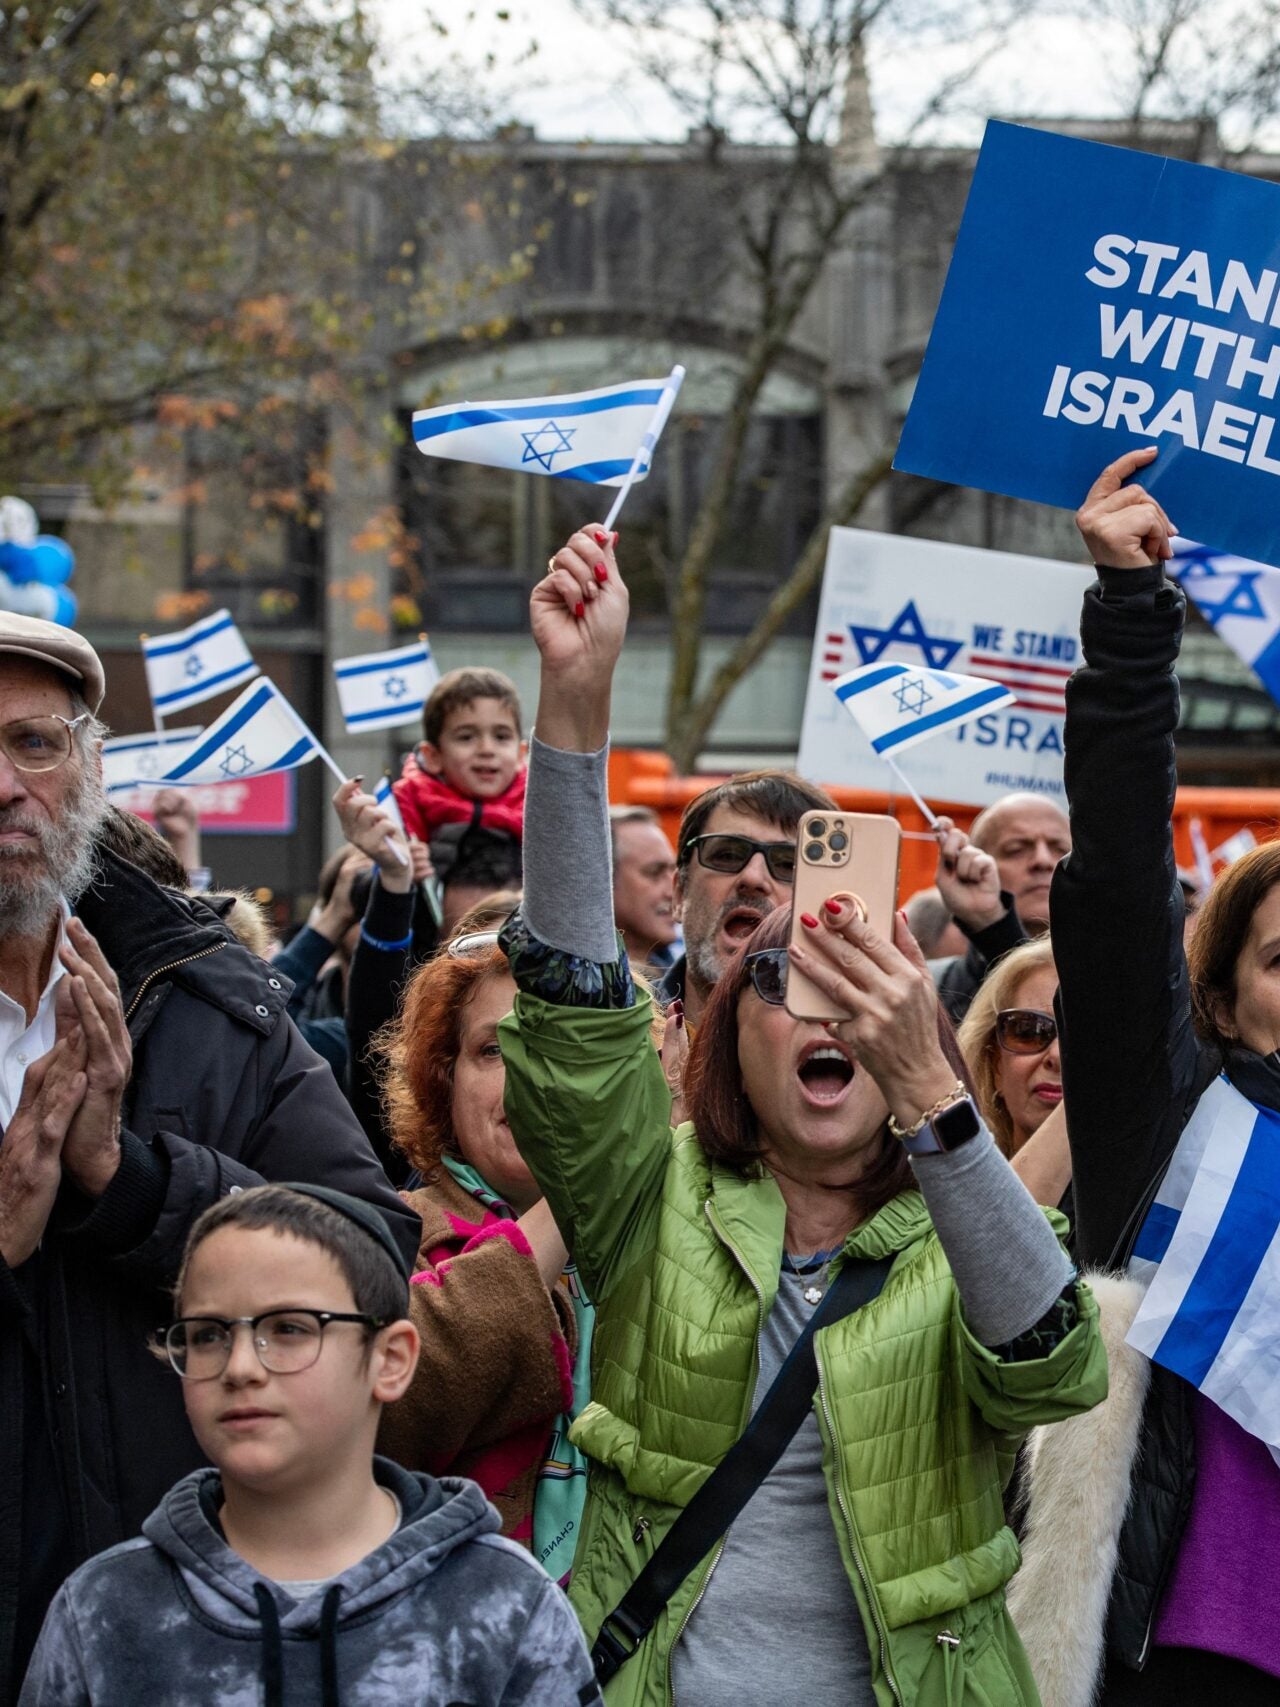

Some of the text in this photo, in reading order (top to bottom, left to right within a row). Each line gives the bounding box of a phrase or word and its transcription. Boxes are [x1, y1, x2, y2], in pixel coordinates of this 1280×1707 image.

[971, 622, 1078, 663] WE STAND
[955, 712, 1065, 757] ISRA
[985, 770, 1063, 794] #HUMANI
